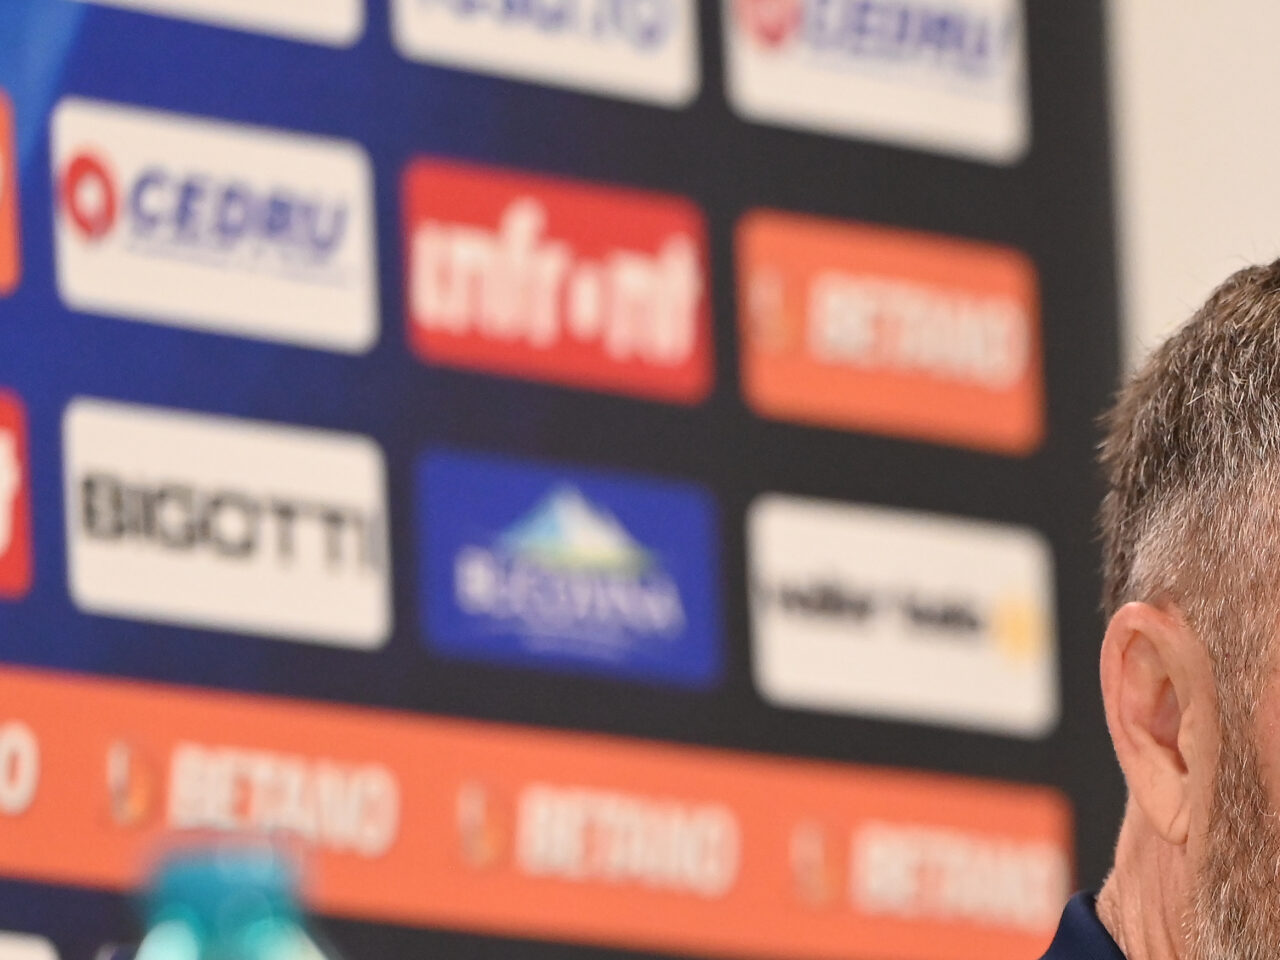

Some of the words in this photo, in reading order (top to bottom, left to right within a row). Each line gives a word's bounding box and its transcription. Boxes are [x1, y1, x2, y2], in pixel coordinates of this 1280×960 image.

[130, 165, 349, 264] CEDRU
[809, 270, 1030, 390] BETANO
[80, 470, 388, 580] BIGOTTI
[167, 740, 401, 859] BETANO
[516, 782, 741, 899] BETANO
[848, 818, 1074, 938] BETANO
